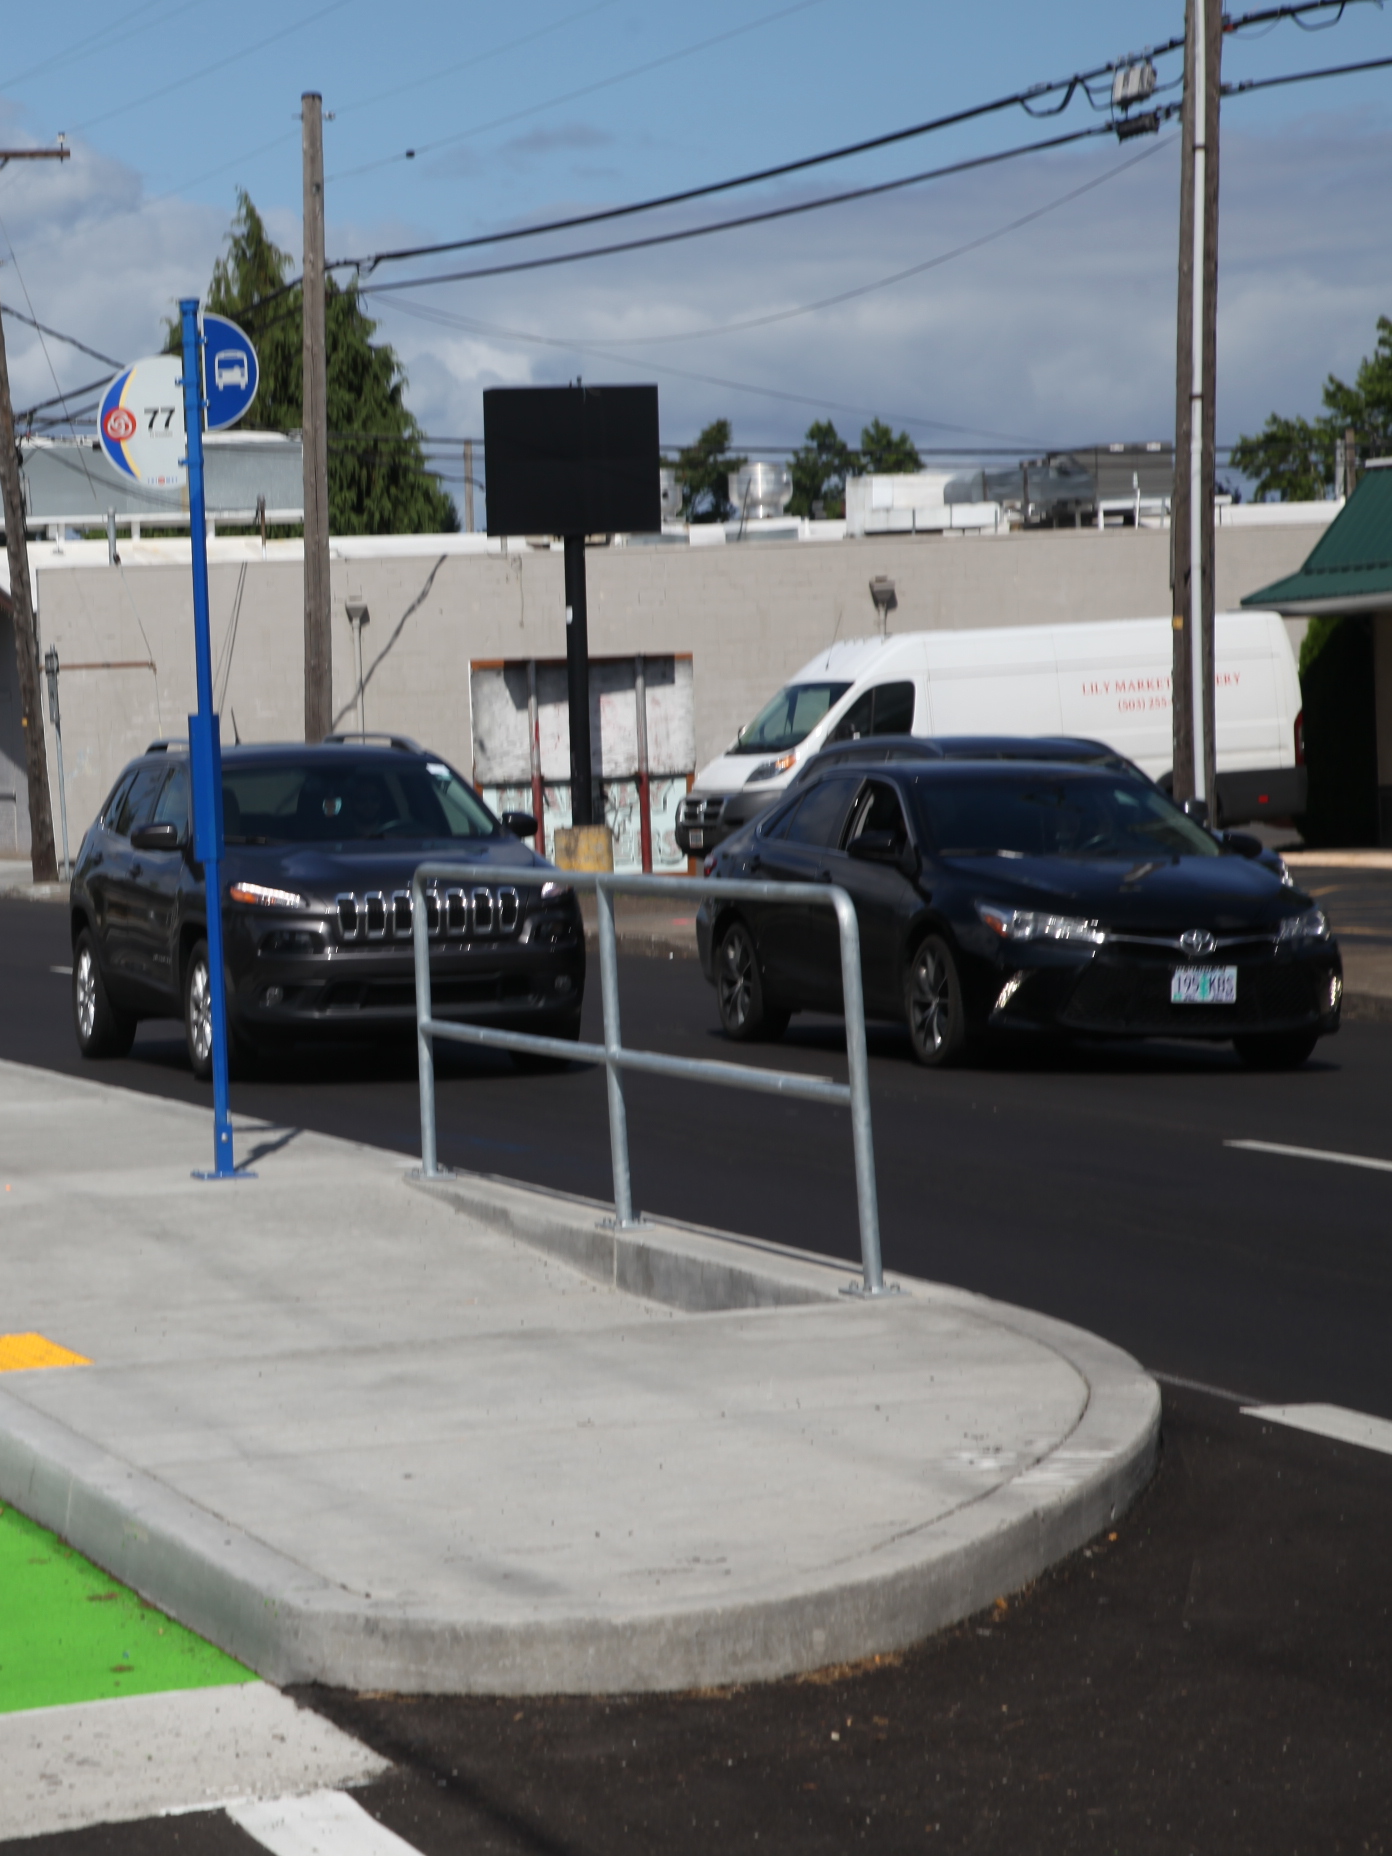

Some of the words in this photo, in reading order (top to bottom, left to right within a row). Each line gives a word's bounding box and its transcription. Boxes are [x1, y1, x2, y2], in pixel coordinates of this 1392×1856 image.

[144, 406, 175, 430] 77
[1082, 680, 1110, 696] LILY
[1115, 676, 1172, 693] MARKET
[1149, 695, 1173, 711] 255-
